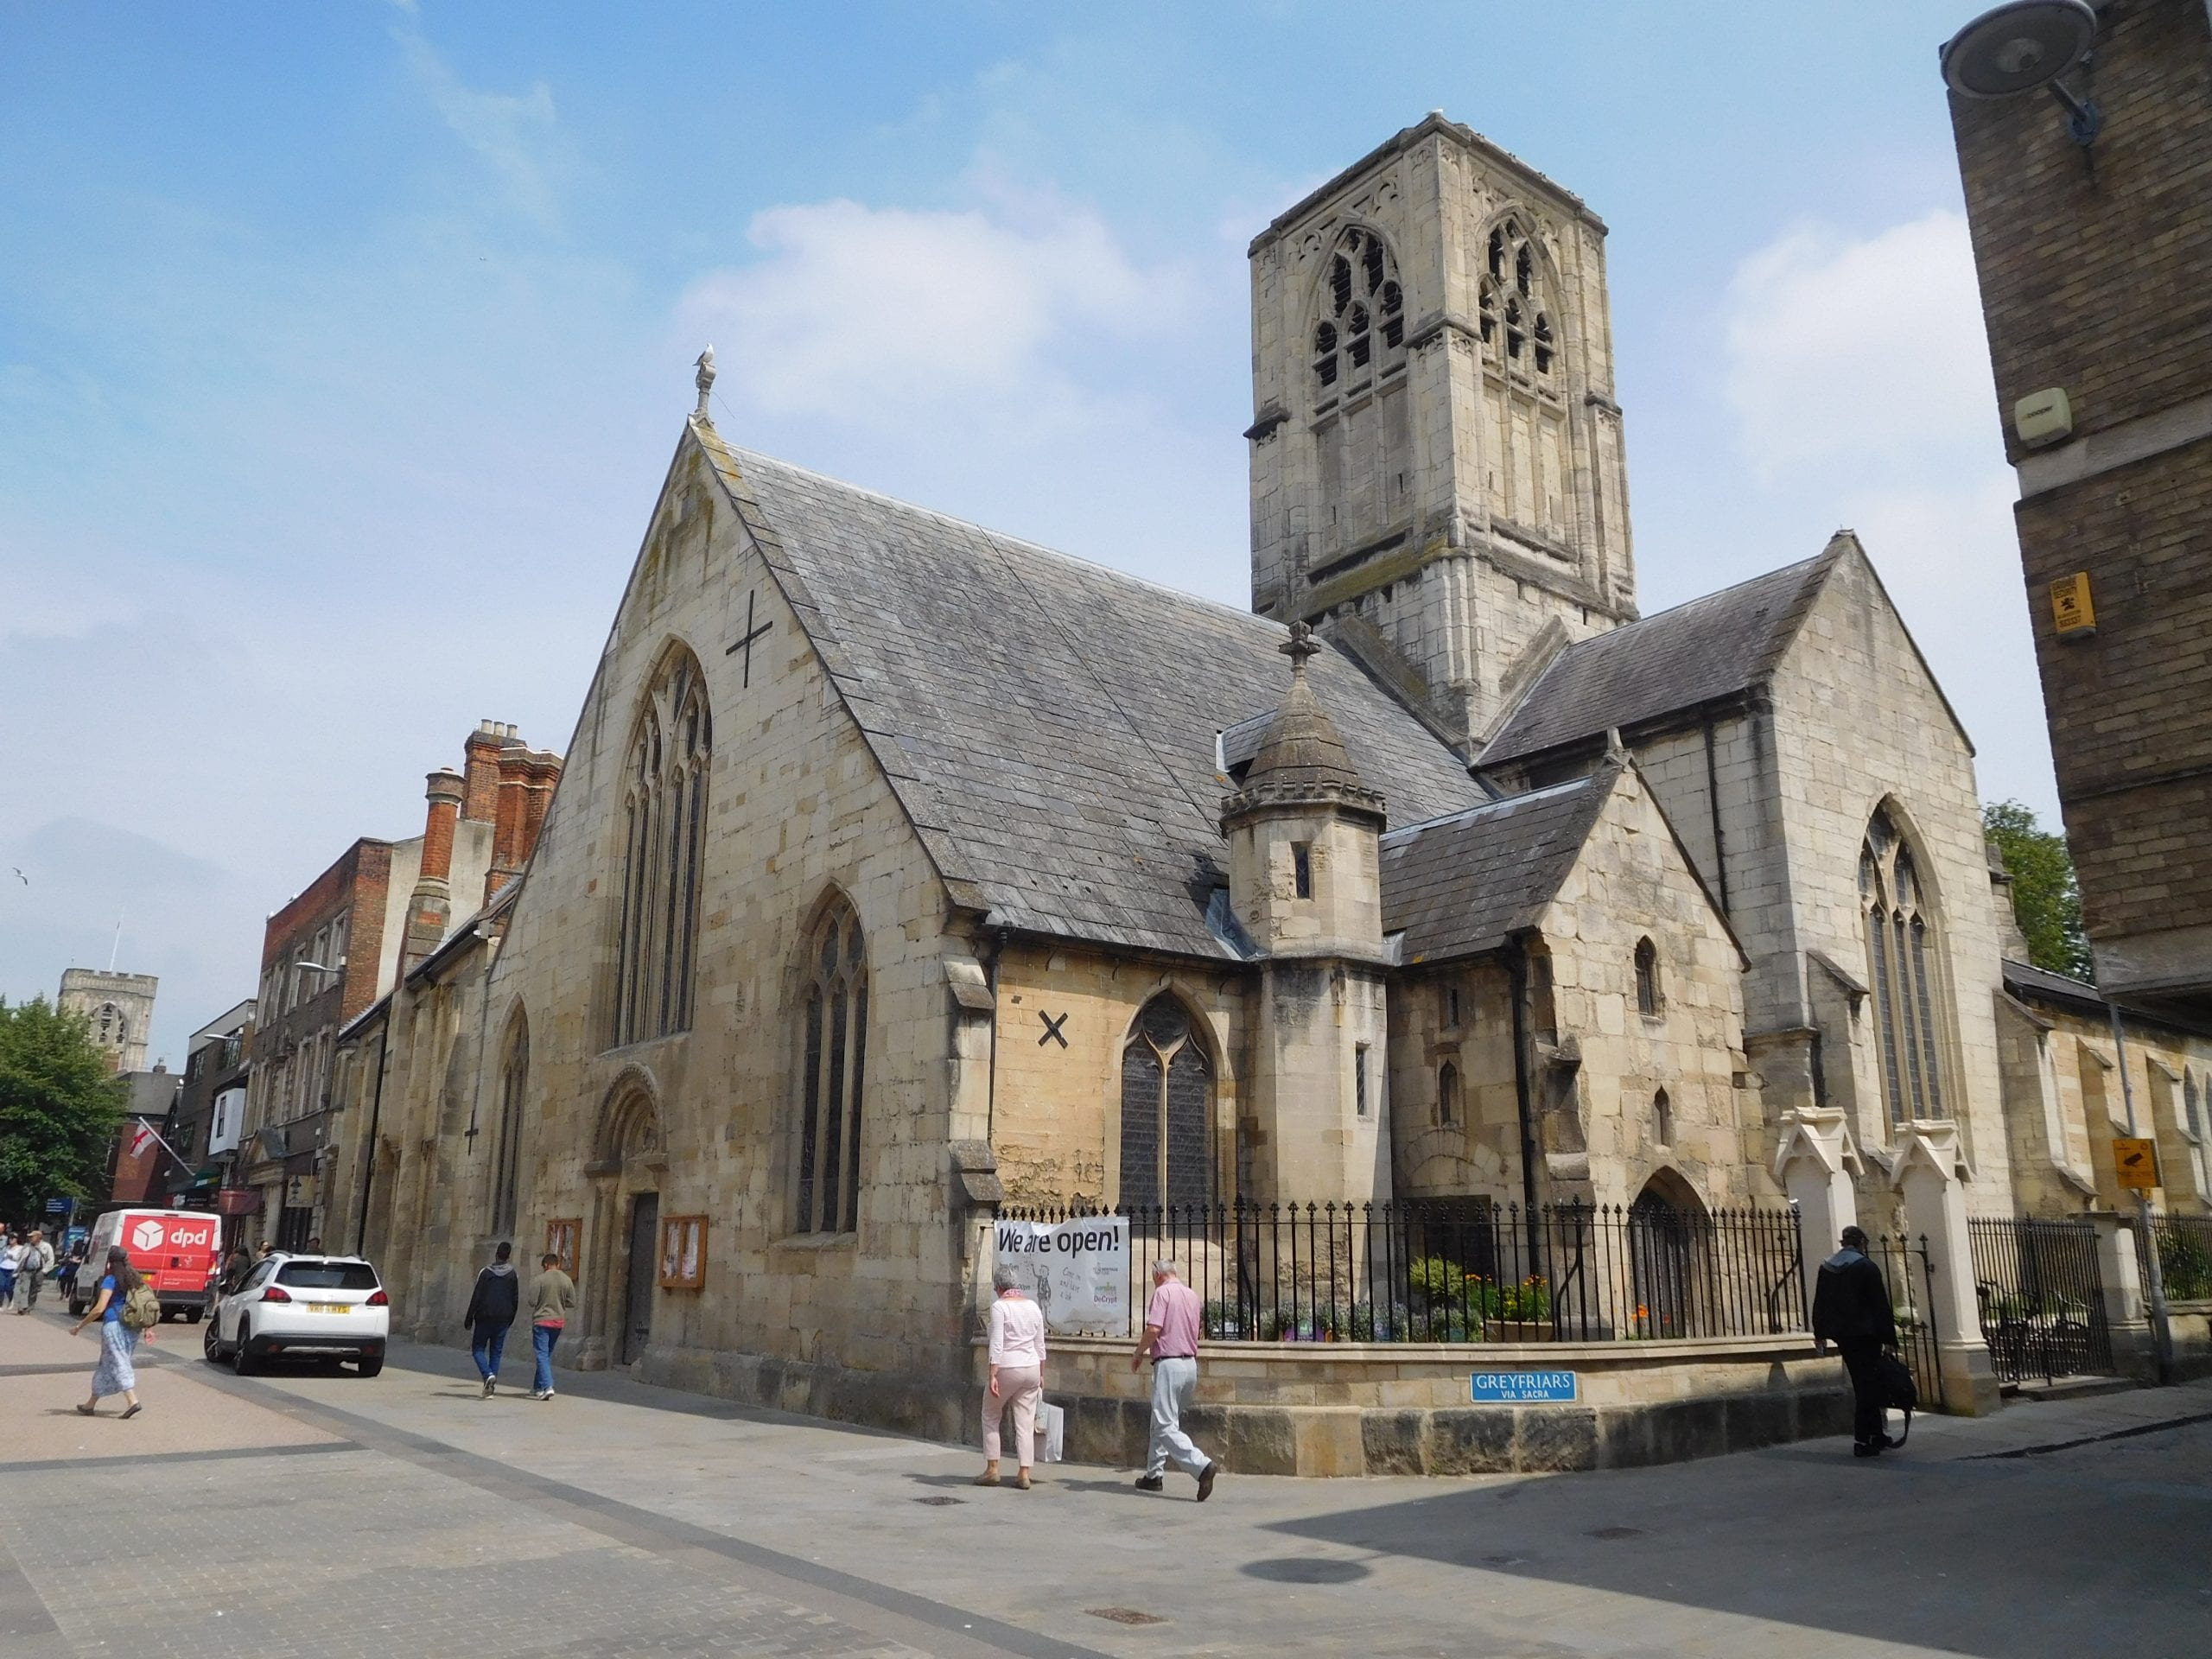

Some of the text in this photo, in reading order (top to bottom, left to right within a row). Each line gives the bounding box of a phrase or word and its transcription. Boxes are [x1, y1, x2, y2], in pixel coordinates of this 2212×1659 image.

[170, 1227, 207, 1248] dpd
[999, 1225, 1119, 1258] We are open!
[1476, 1374, 1570, 1389] GREYFRIARS
[1501, 1389, 1549, 1399] VIA SACRA
